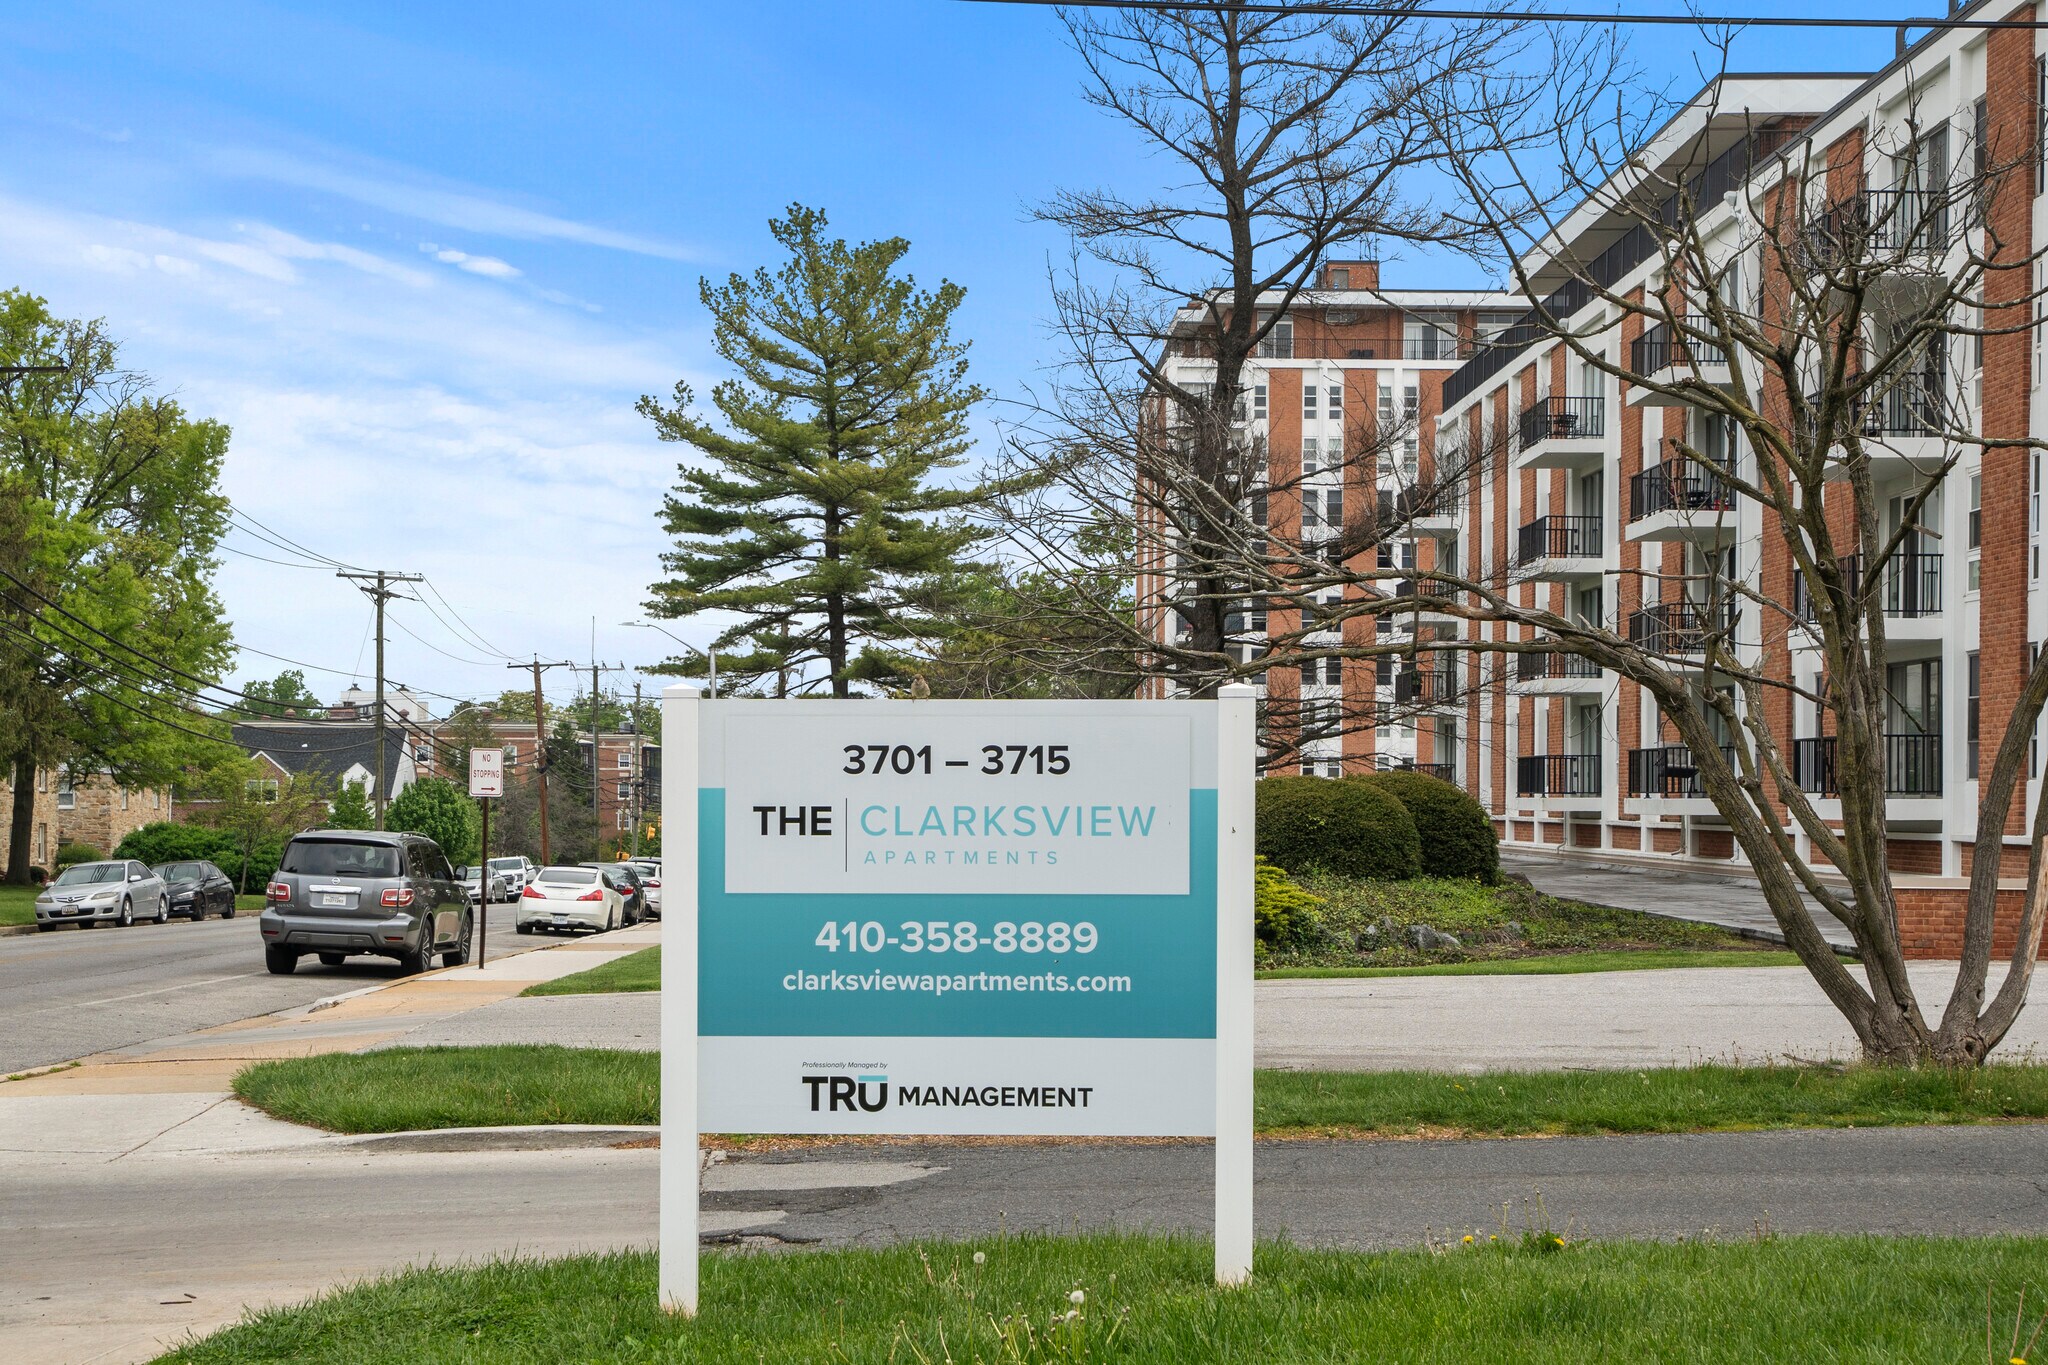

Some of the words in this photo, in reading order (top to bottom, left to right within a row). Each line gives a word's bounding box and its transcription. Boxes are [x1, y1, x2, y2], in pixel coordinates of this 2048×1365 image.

[482, 753, 491, 762] NO
[843, 745, 932, 775] 3701
[981, 745, 1071, 775] 3715
[473, 769, 500, 778] STOPPING
[753, 805, 832, 836] THE
[860, 805, 1157, 837] CLARKSVIEW
[864, 850, 1058, 865] APARTMENTS
[815, 920, 1099, 954] 410-358-8889
[782, 969, 1131, 996] clarksviewapartments.com
[802, 1061, 847, 1070] Professionally
[848, 1061, 878, 1070] Managed
[879, 1061, 888, 1070] by
[899, 1086, 1094, 1108] MANAGEMENT
